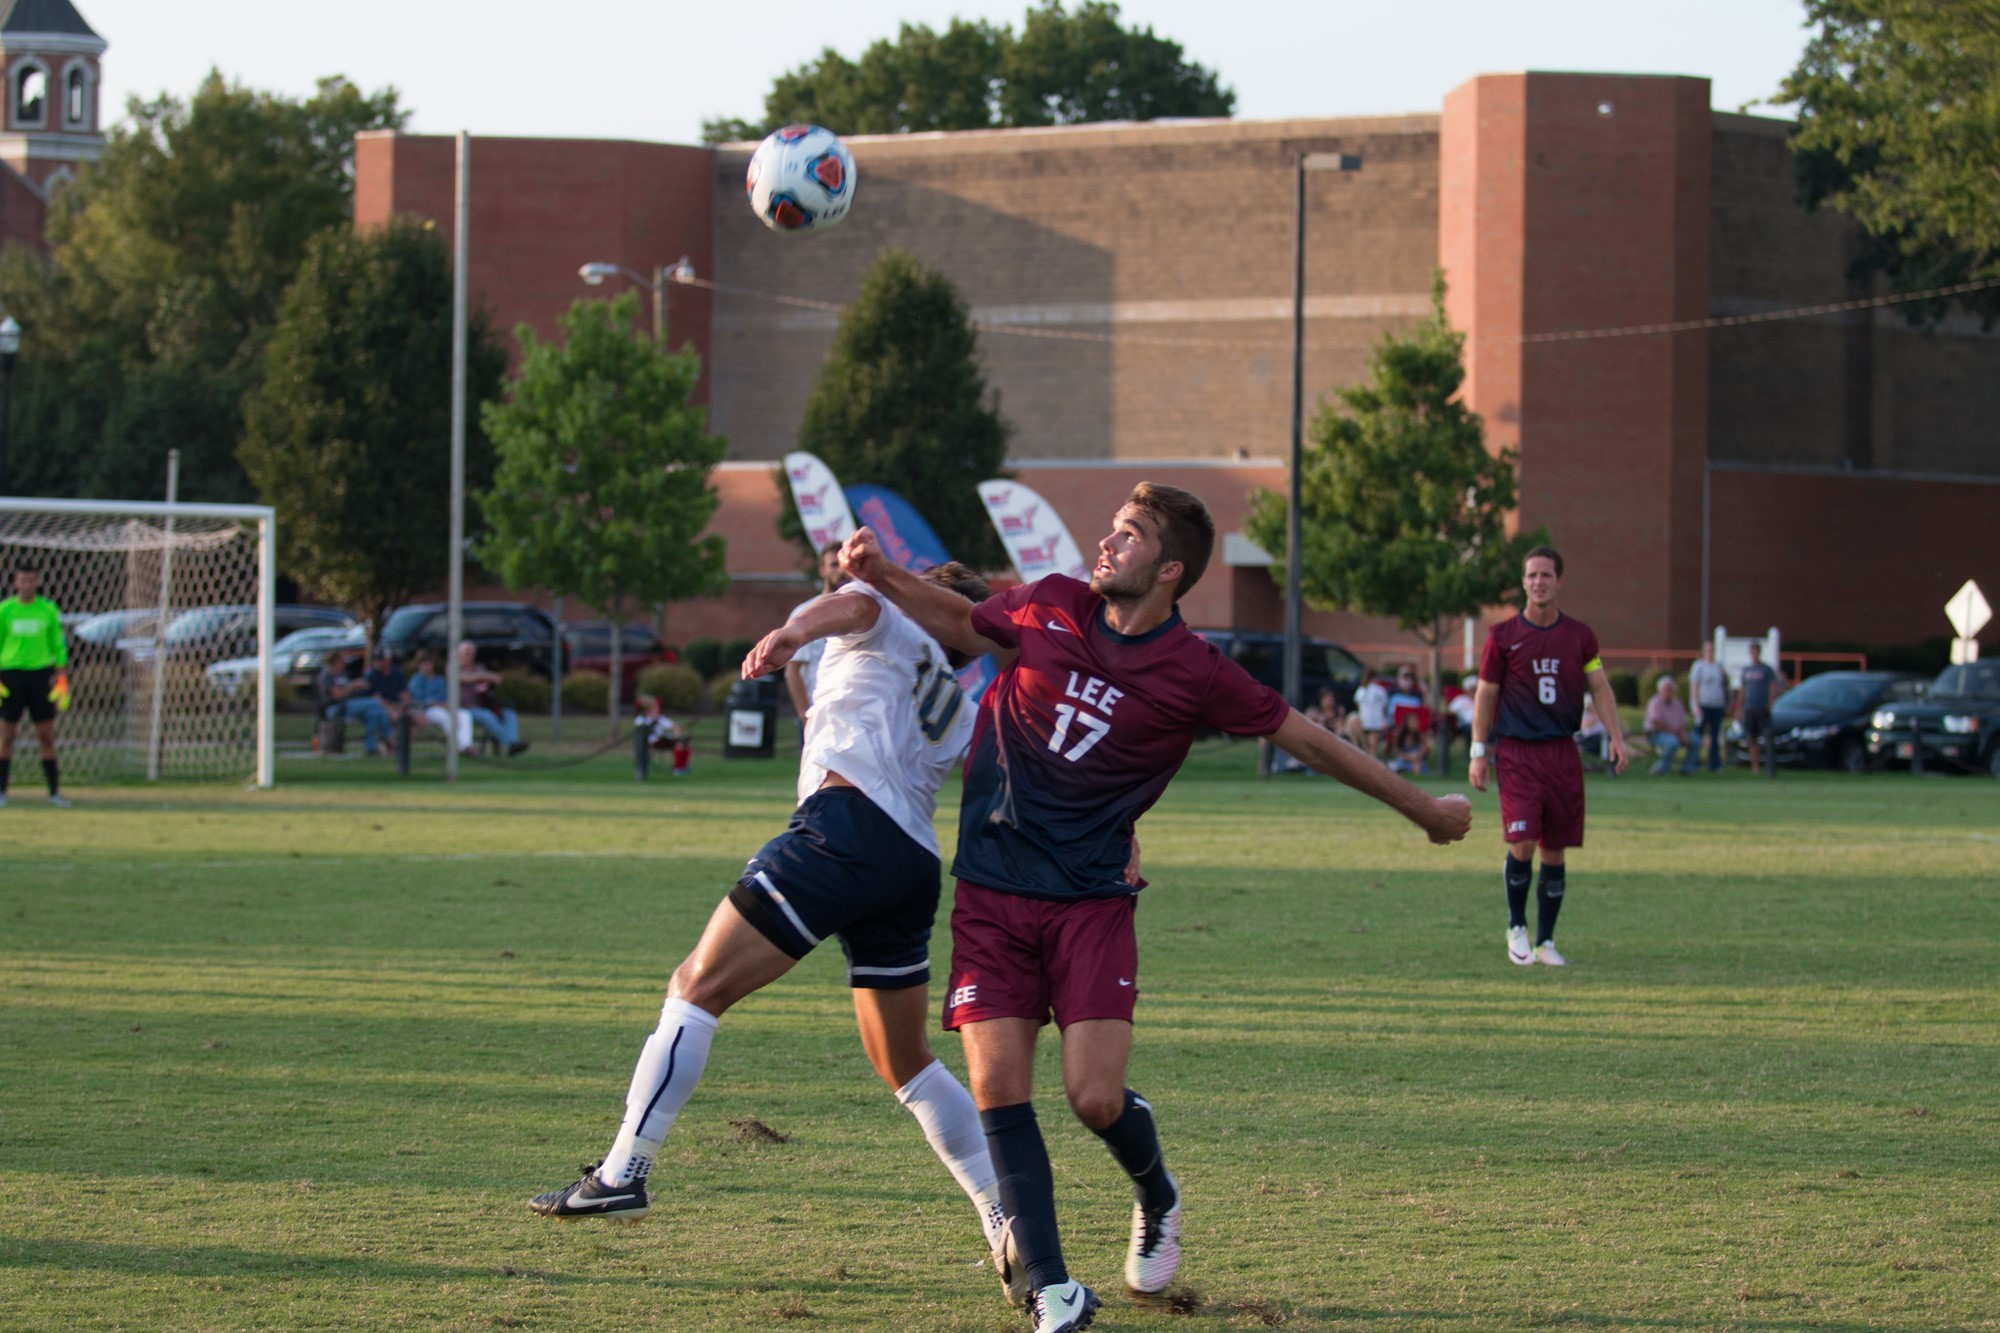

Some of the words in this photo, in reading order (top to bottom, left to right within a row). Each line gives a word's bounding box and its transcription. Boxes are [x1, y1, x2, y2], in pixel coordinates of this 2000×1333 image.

[1532, 657, 1560, 674] LEE
[1065, 670, 1124, 716] LEE
[1538, 676, 1556, 704] 6
[1047, 703, 1111, 762] 17
